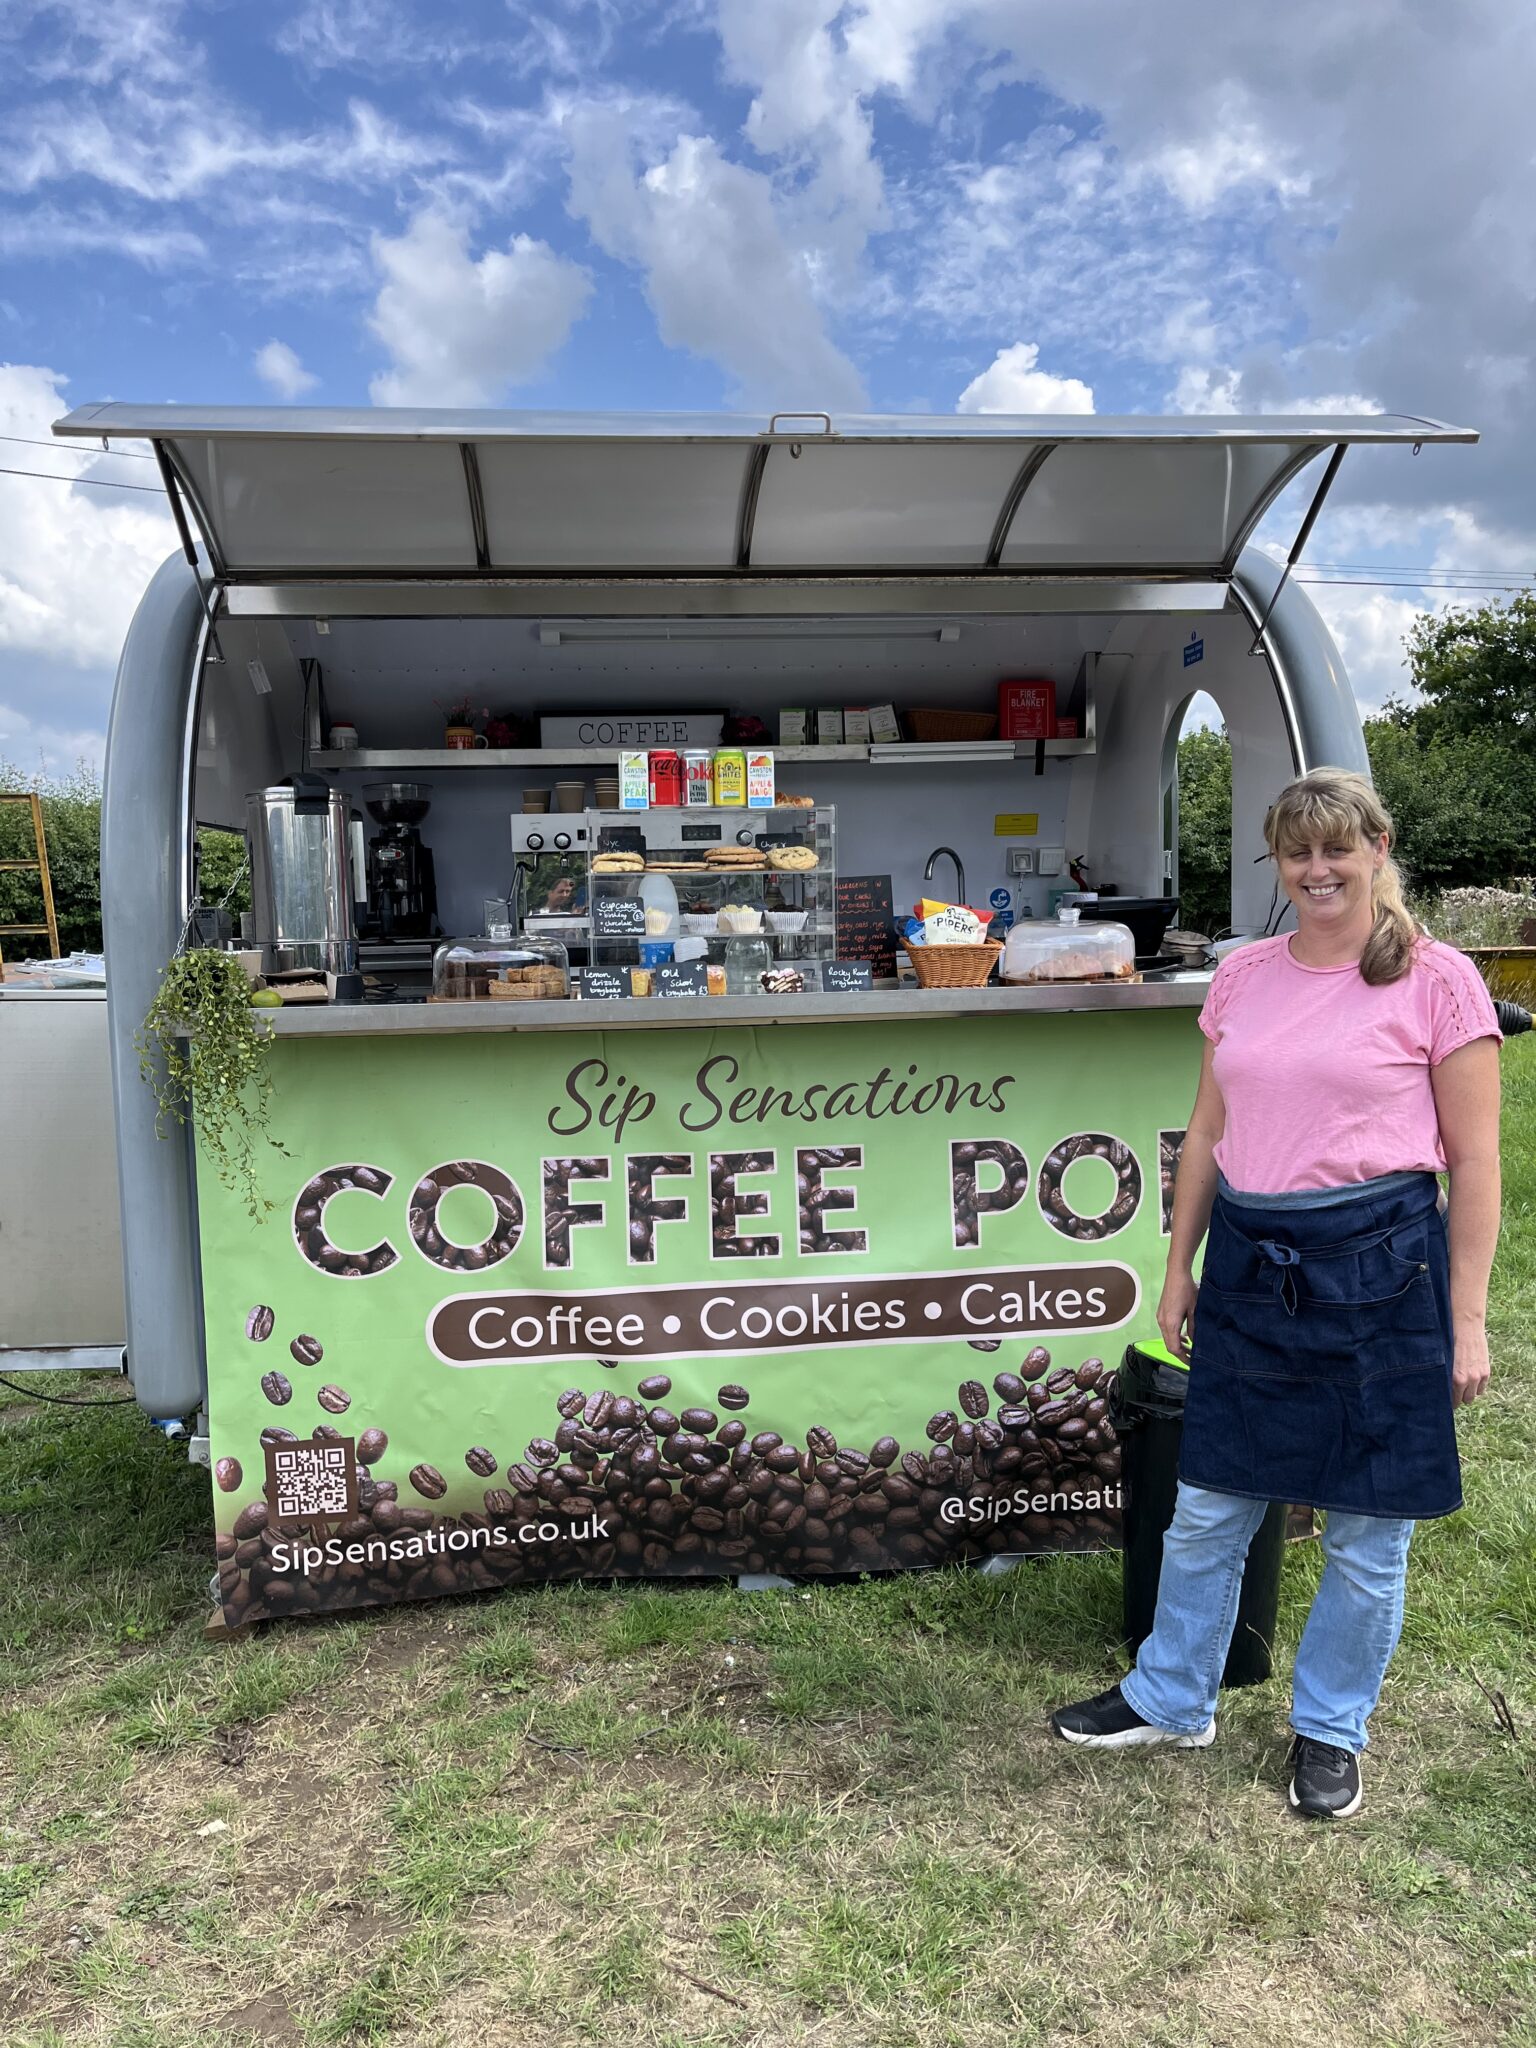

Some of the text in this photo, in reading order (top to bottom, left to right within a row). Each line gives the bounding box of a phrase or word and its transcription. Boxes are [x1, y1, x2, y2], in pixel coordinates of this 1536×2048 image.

[1011, 698, 1046, 708] BLANKET
[1020, 690, 1037, 699] FIRE
[578, 721, 689, 745] COFFEE
[624, 788, 647, 797] PEAR
[936, 917, 974, 935] PIPERS
[584, 969, 611, 979] Lemon
[661, 969, 680, 978] Old
[828, 966, 869, 980] Rocky Road
[547, 1055, 1015, 1144] Sip Sensations
[291, 1144, 870, 1280] COFFEE
[467, 1280, 1107, 1350] Coffee Cookies Cakes
[940, 1483, 1122, 1524] @SipSensati
[271, 1513, 610, 1576] SipSensations.co.uk
